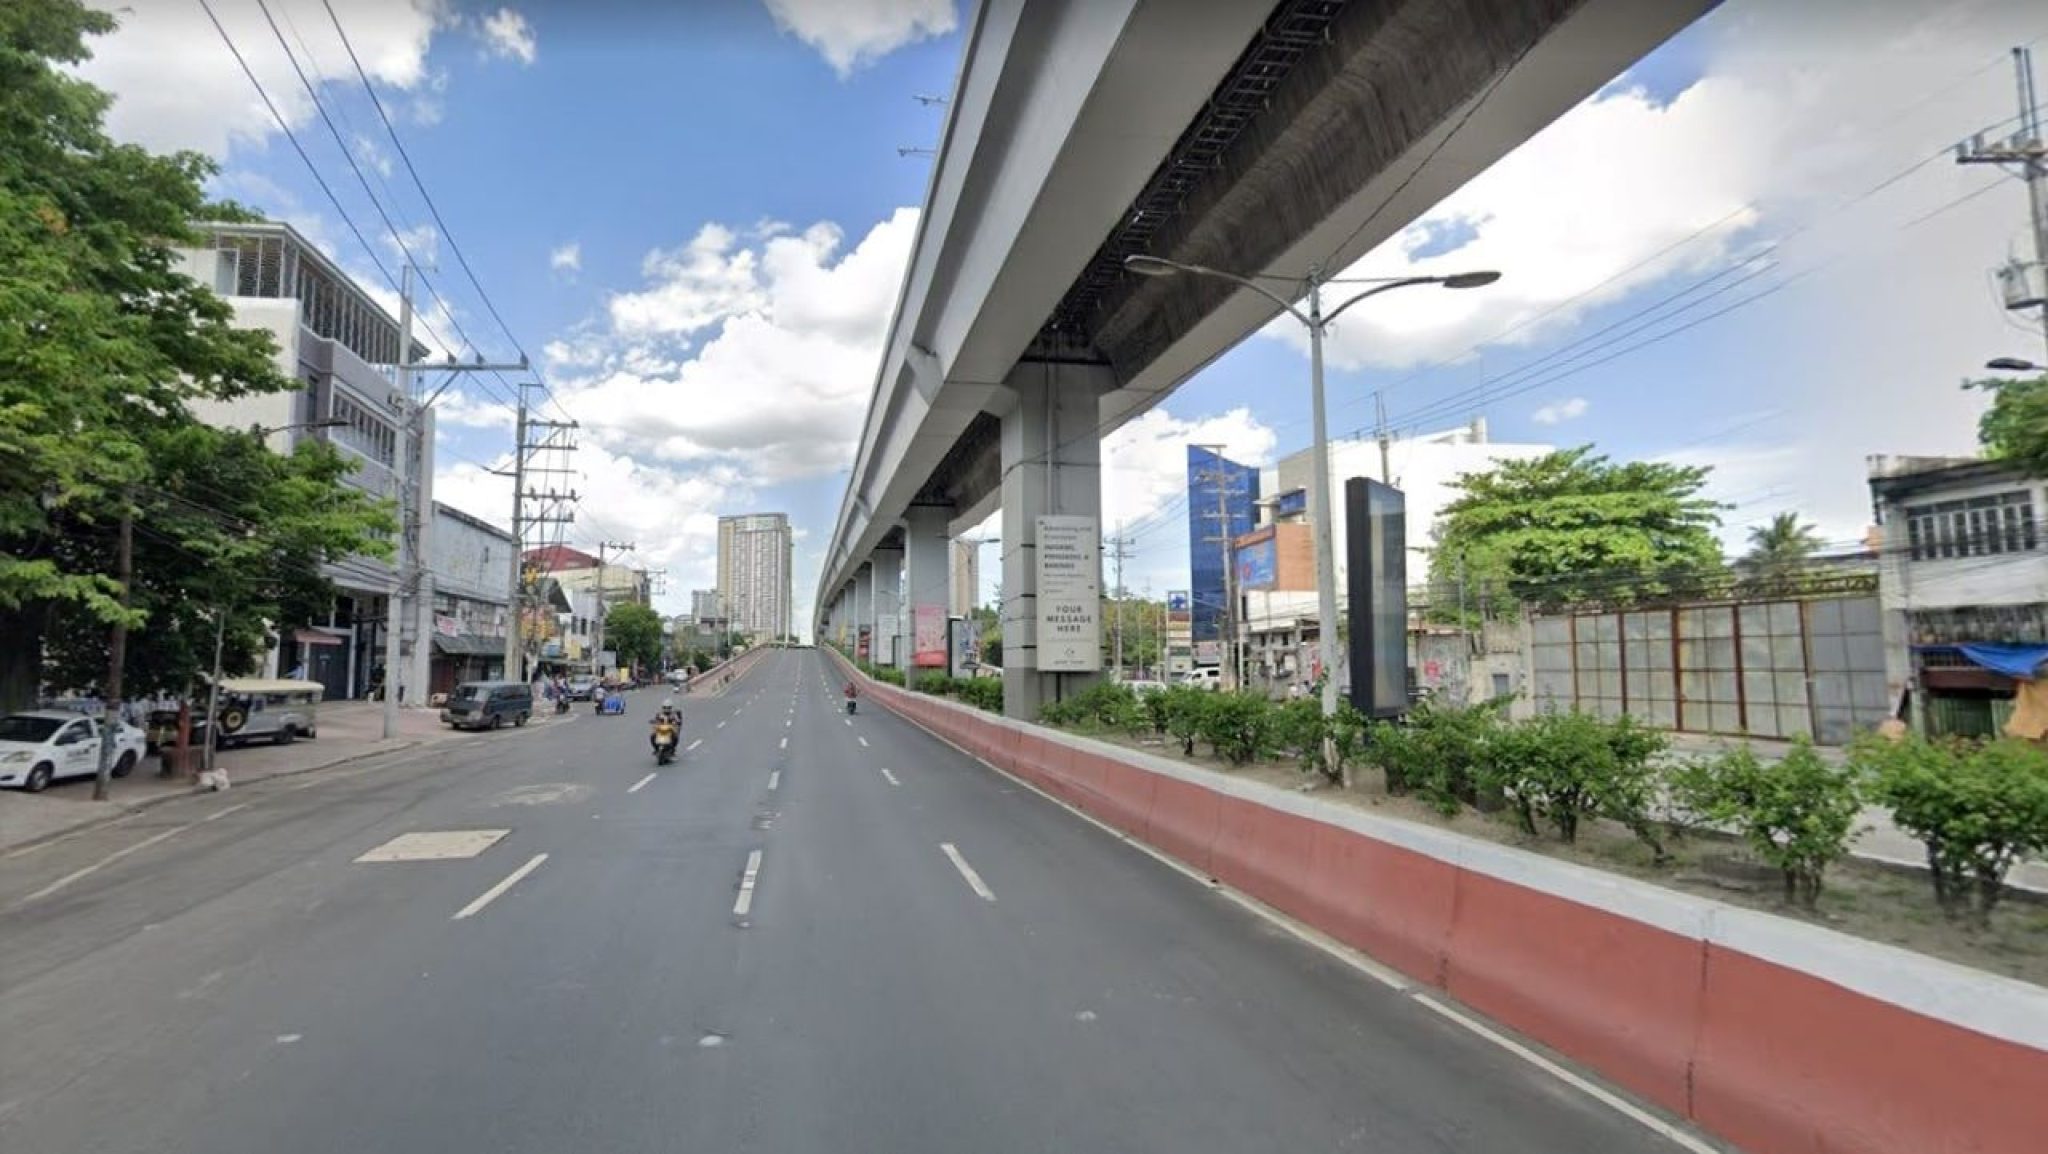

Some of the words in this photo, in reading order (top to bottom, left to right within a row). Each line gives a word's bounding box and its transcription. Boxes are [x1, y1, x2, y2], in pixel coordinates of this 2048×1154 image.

[1055, 605, 1082, 613] YOUR
[1046, 615, 1092, 623] MESSAGE
[1056, 624, 1081, 633] HERE
